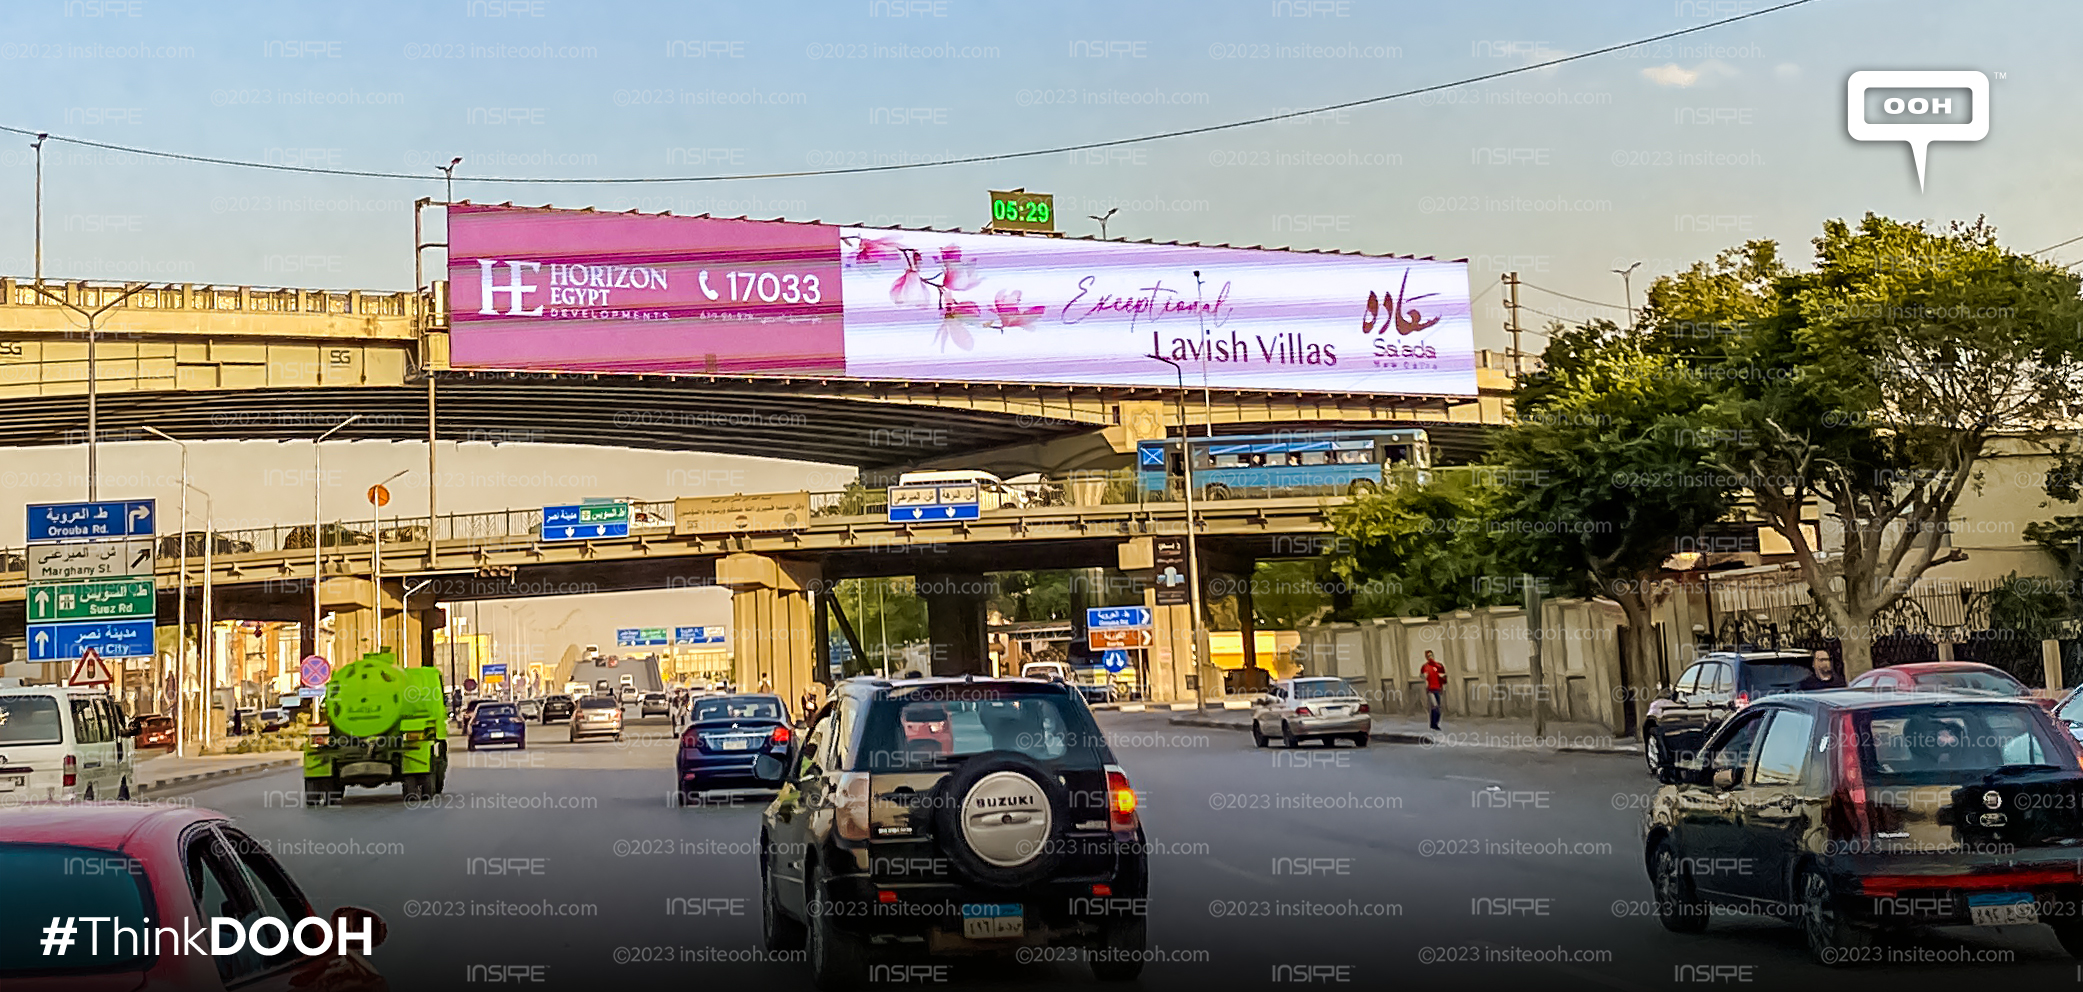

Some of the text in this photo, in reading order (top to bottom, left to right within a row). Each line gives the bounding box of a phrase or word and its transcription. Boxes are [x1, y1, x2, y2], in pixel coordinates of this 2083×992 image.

[993, 199, 1050, 224] 05:29
[550, 263, 669, 291] HORIZON
[725, 271, 822, 305] 17033
[550, 287, 611, 307] EGYPT
[550, 308, 671, 322] DEVELOPMENTS
[1152, 329, 1338, 366] Lavish Villas
[47, 525, 89, 537] Orouba
[41, 566, 96, 577] Marghany
[89, 604, 116, 615] Suez
[105, 643, 130, 655] City
[976, 795, 1035, 808] SUZUKI
